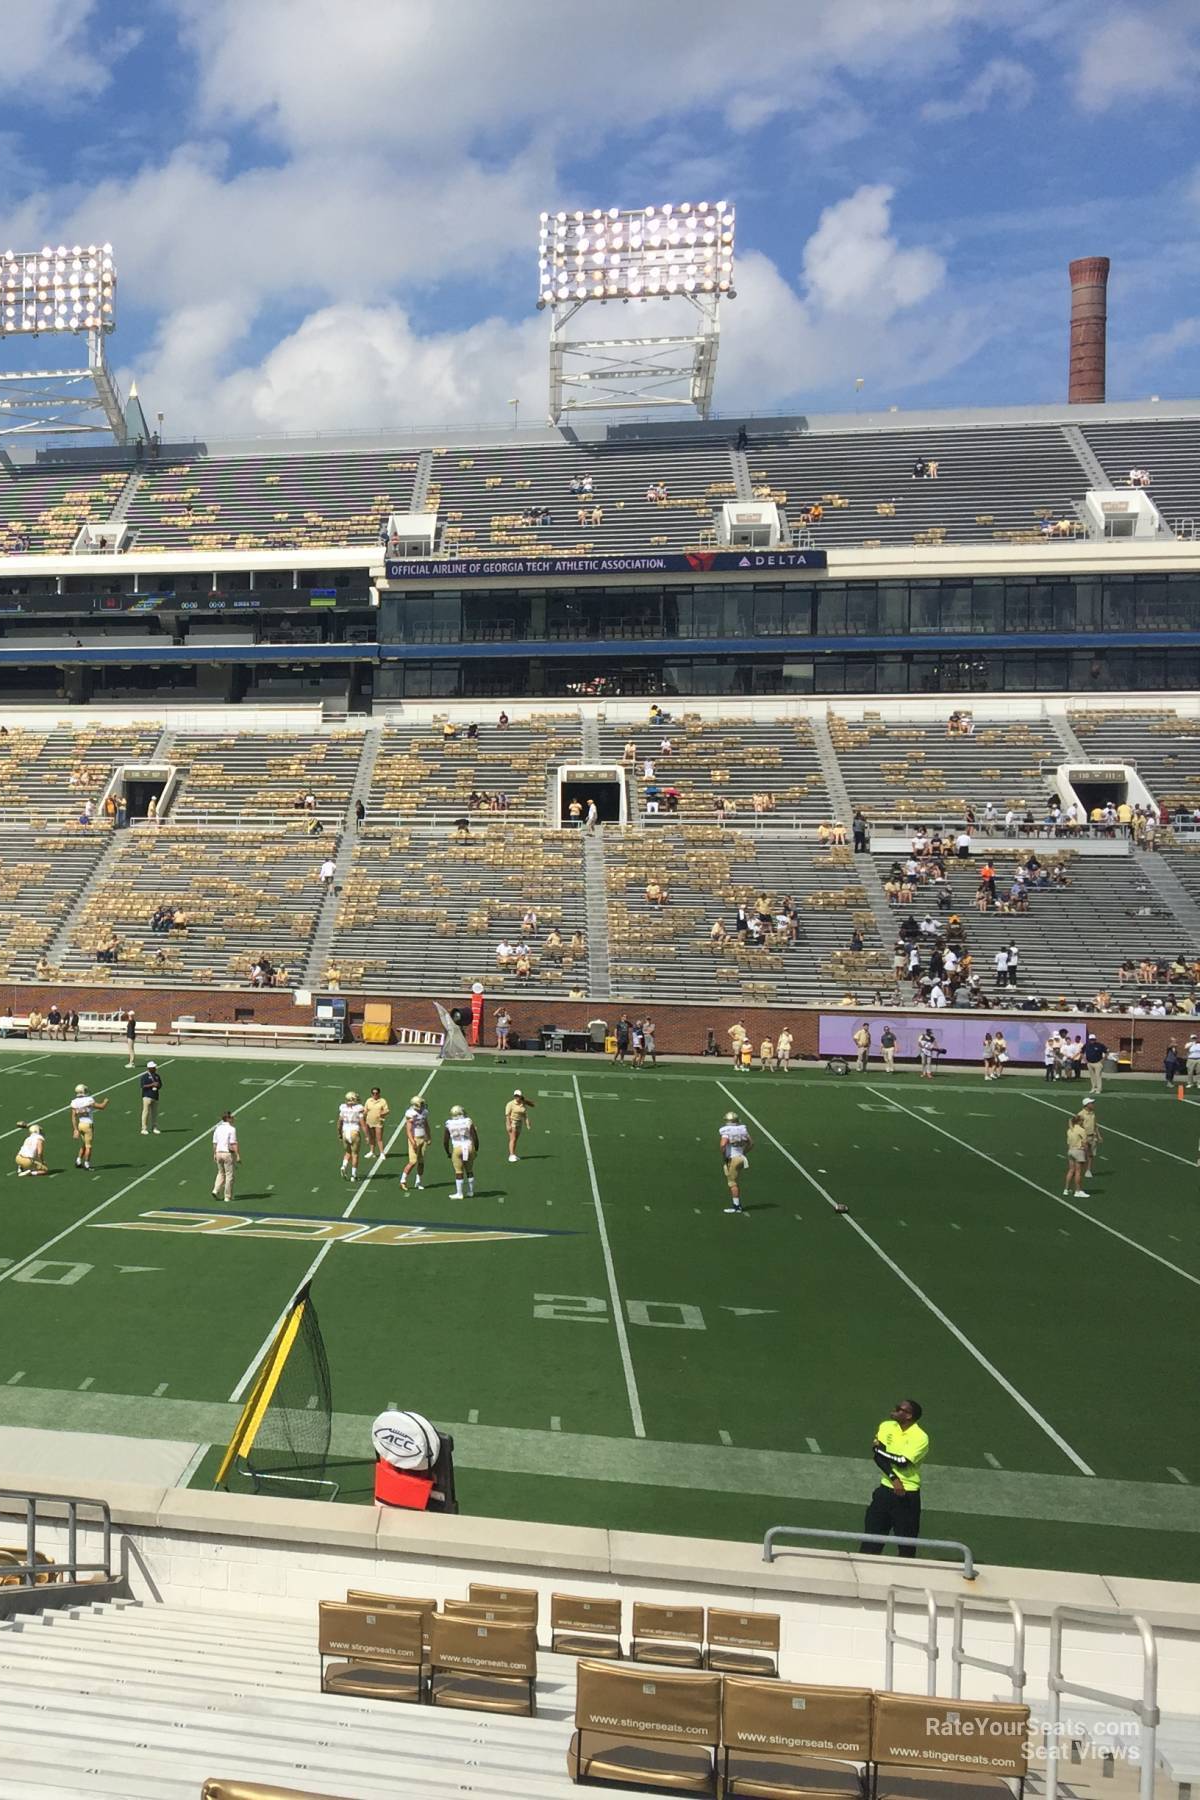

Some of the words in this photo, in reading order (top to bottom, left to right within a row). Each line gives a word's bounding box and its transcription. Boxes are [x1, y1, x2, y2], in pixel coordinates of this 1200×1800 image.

[391, 563, 431, 577] OFFICIAL
[432, 562, 467, 575] AIRLINE
[469, 562, 481, 574] OF
[483, 561, 523, 574] GEORGIA
[555, 559, 598, 572] ATHLETIC
[755, 555, 807, 567] DELTA
[533, 1292, 707, 1331] 20
[381, 1434, 414, 1451] ACC
[329, 1640, 415, 1658] www.stingerseats.com
[439, 1652, 528, 1671] www.stingerseats.com
[589, 1712, 709, 1736] www.stingerseats.com
[736, 1730, 860, 1753] www.stingerseats.com
[889, 1745, 1017, 1769] www.stingerseats.com
